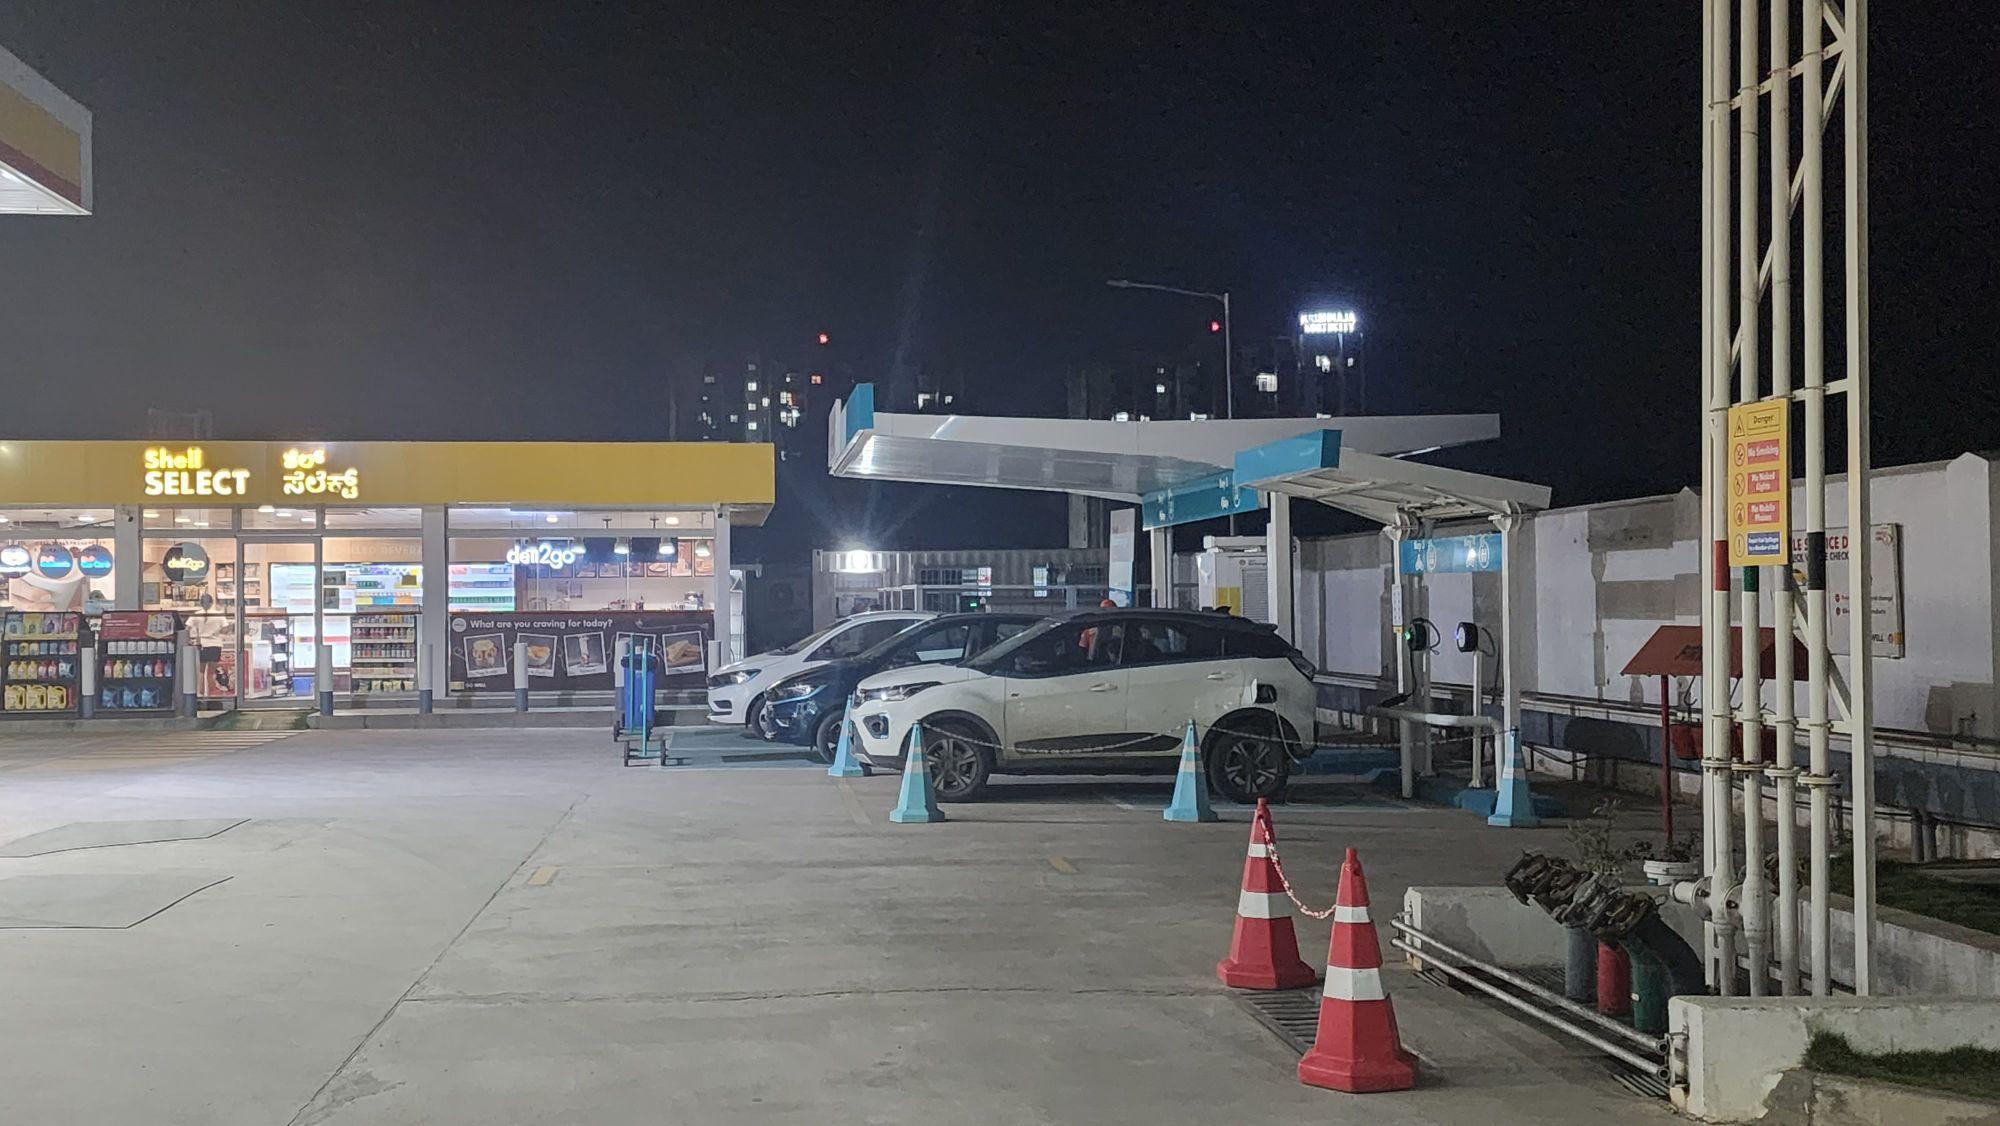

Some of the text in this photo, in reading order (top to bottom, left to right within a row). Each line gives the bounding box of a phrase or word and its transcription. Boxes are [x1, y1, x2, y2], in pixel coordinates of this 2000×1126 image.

[1753, 414, 1775, 425] Danger
[144, 447, 204, 470] Shell
[144, 470, 251, 496] SELECT
[470, 618, 614, 630] What are you craving for today?
